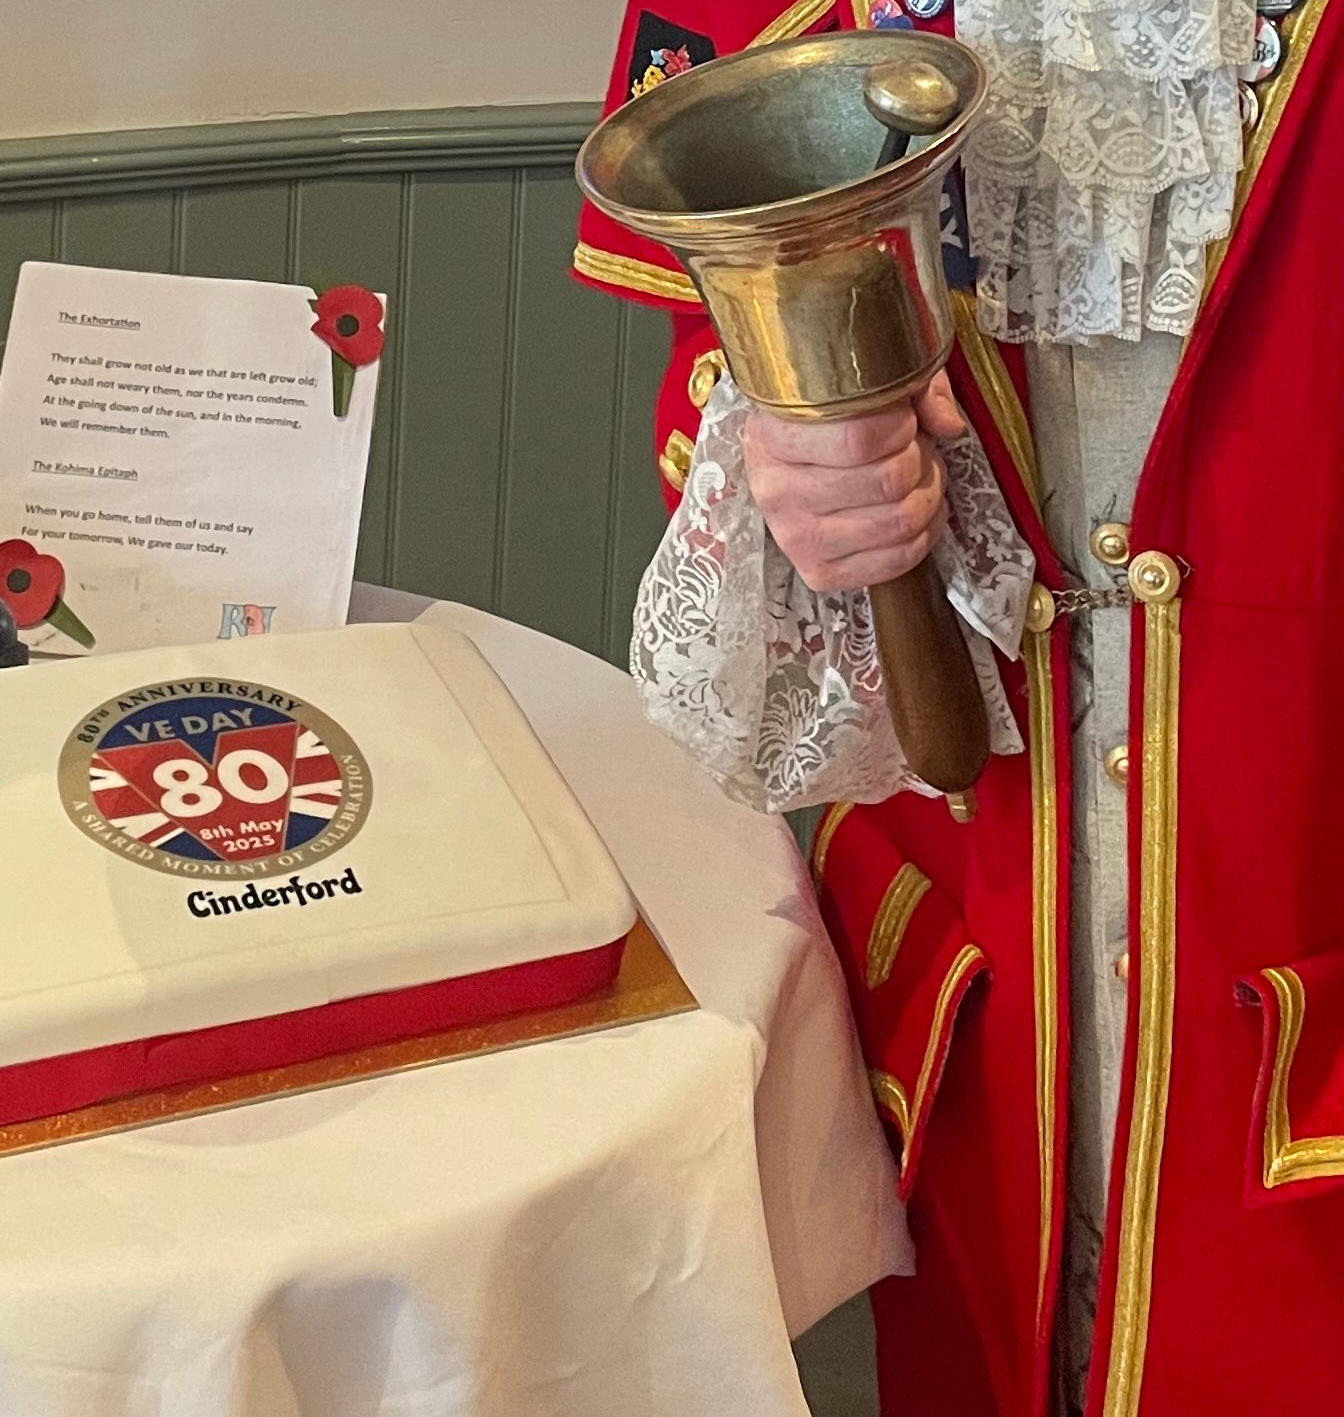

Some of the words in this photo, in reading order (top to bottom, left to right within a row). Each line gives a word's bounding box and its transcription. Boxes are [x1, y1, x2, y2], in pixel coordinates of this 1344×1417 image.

[58, 312, 78, 322] The
[81, 314, 141, 328] Exhortation
[51, 353, 76, 365] They
[79, 356, 103, 365] shall
[105, 360, 132, 369] grow
[134, 362, 152, 371] not
[154, 364, 172, 373] old
[174, 367, 186, 375] as
[207, 369, 227, 378] that
[230, 371, 247, 380] are
[250, 371, 267, 381] left
[269, 375, 295, 384] grow
[47, 374, 67, 386] Age
[70, 377, 94, 386] shall
[96, 380, 115, 389] not
[117, 382, 150, 394] weary
[186, 389, 204, 398] nor
[207, 390, 224, 399] the
[226, 393, 254, 402] years
[42, 395, 55, 405] At
[58, 397, 76, 407] the
[77, 399, 107, 412] going
[109, 402, 139, 412] down
[141, 405, 153, 414] of
[155, 407, 173, 417] the
[200, 412, 220, 421] and
[222, 413, 232, 421] in
[235, 414, 252, 423] the
[40, 417, 57, 427] We
[60, 420, 80, 429] will
[81, 422, 138, 435] remember
[33, 460, 53, 471] The
[55, 463, 95, 475] Kohima
[97, 466, 138, 479] Epitaph
[25, 504, 56, 516] When
[60, 509, 80, 518] you
[81, 511, 96, 521] go
[135, 515, 152, 524] tell
[155, 516, 182, 528] them
[185, 518, 197, 529] of
[199, 522, 211, 531] us
[214, 523, 234, 532] and
[236, 525, 254, 536] say
[21, 526, 39, 536] For
[41, 530, 67, 540] your
[128, 536, 145, 547] We
[147, 540, 172, 549] gave
[175, 542, 194, 551] our
[77, 709, 111, 743] 80TH
[116, 681, 302, 713] ANNIVERSARY
[123, 720, 176, 742] VE
[181, 707, 254, 735] DAY
[153, 749, 289, 818] 80
[72, 800, 88, 811] A
[81, 813, 155, 861] SHARED
[161, 857, 270, 875] MOMENT
[277, 849, 305, 866] OF
[309, 754, 364, 853] CELEBRATION
[200, 825, 234, 840] 8th
[239, 818, 284, 833] May
[223, 834, 276, 853] 2025
[187, 868, 362, 918] Cinderford
